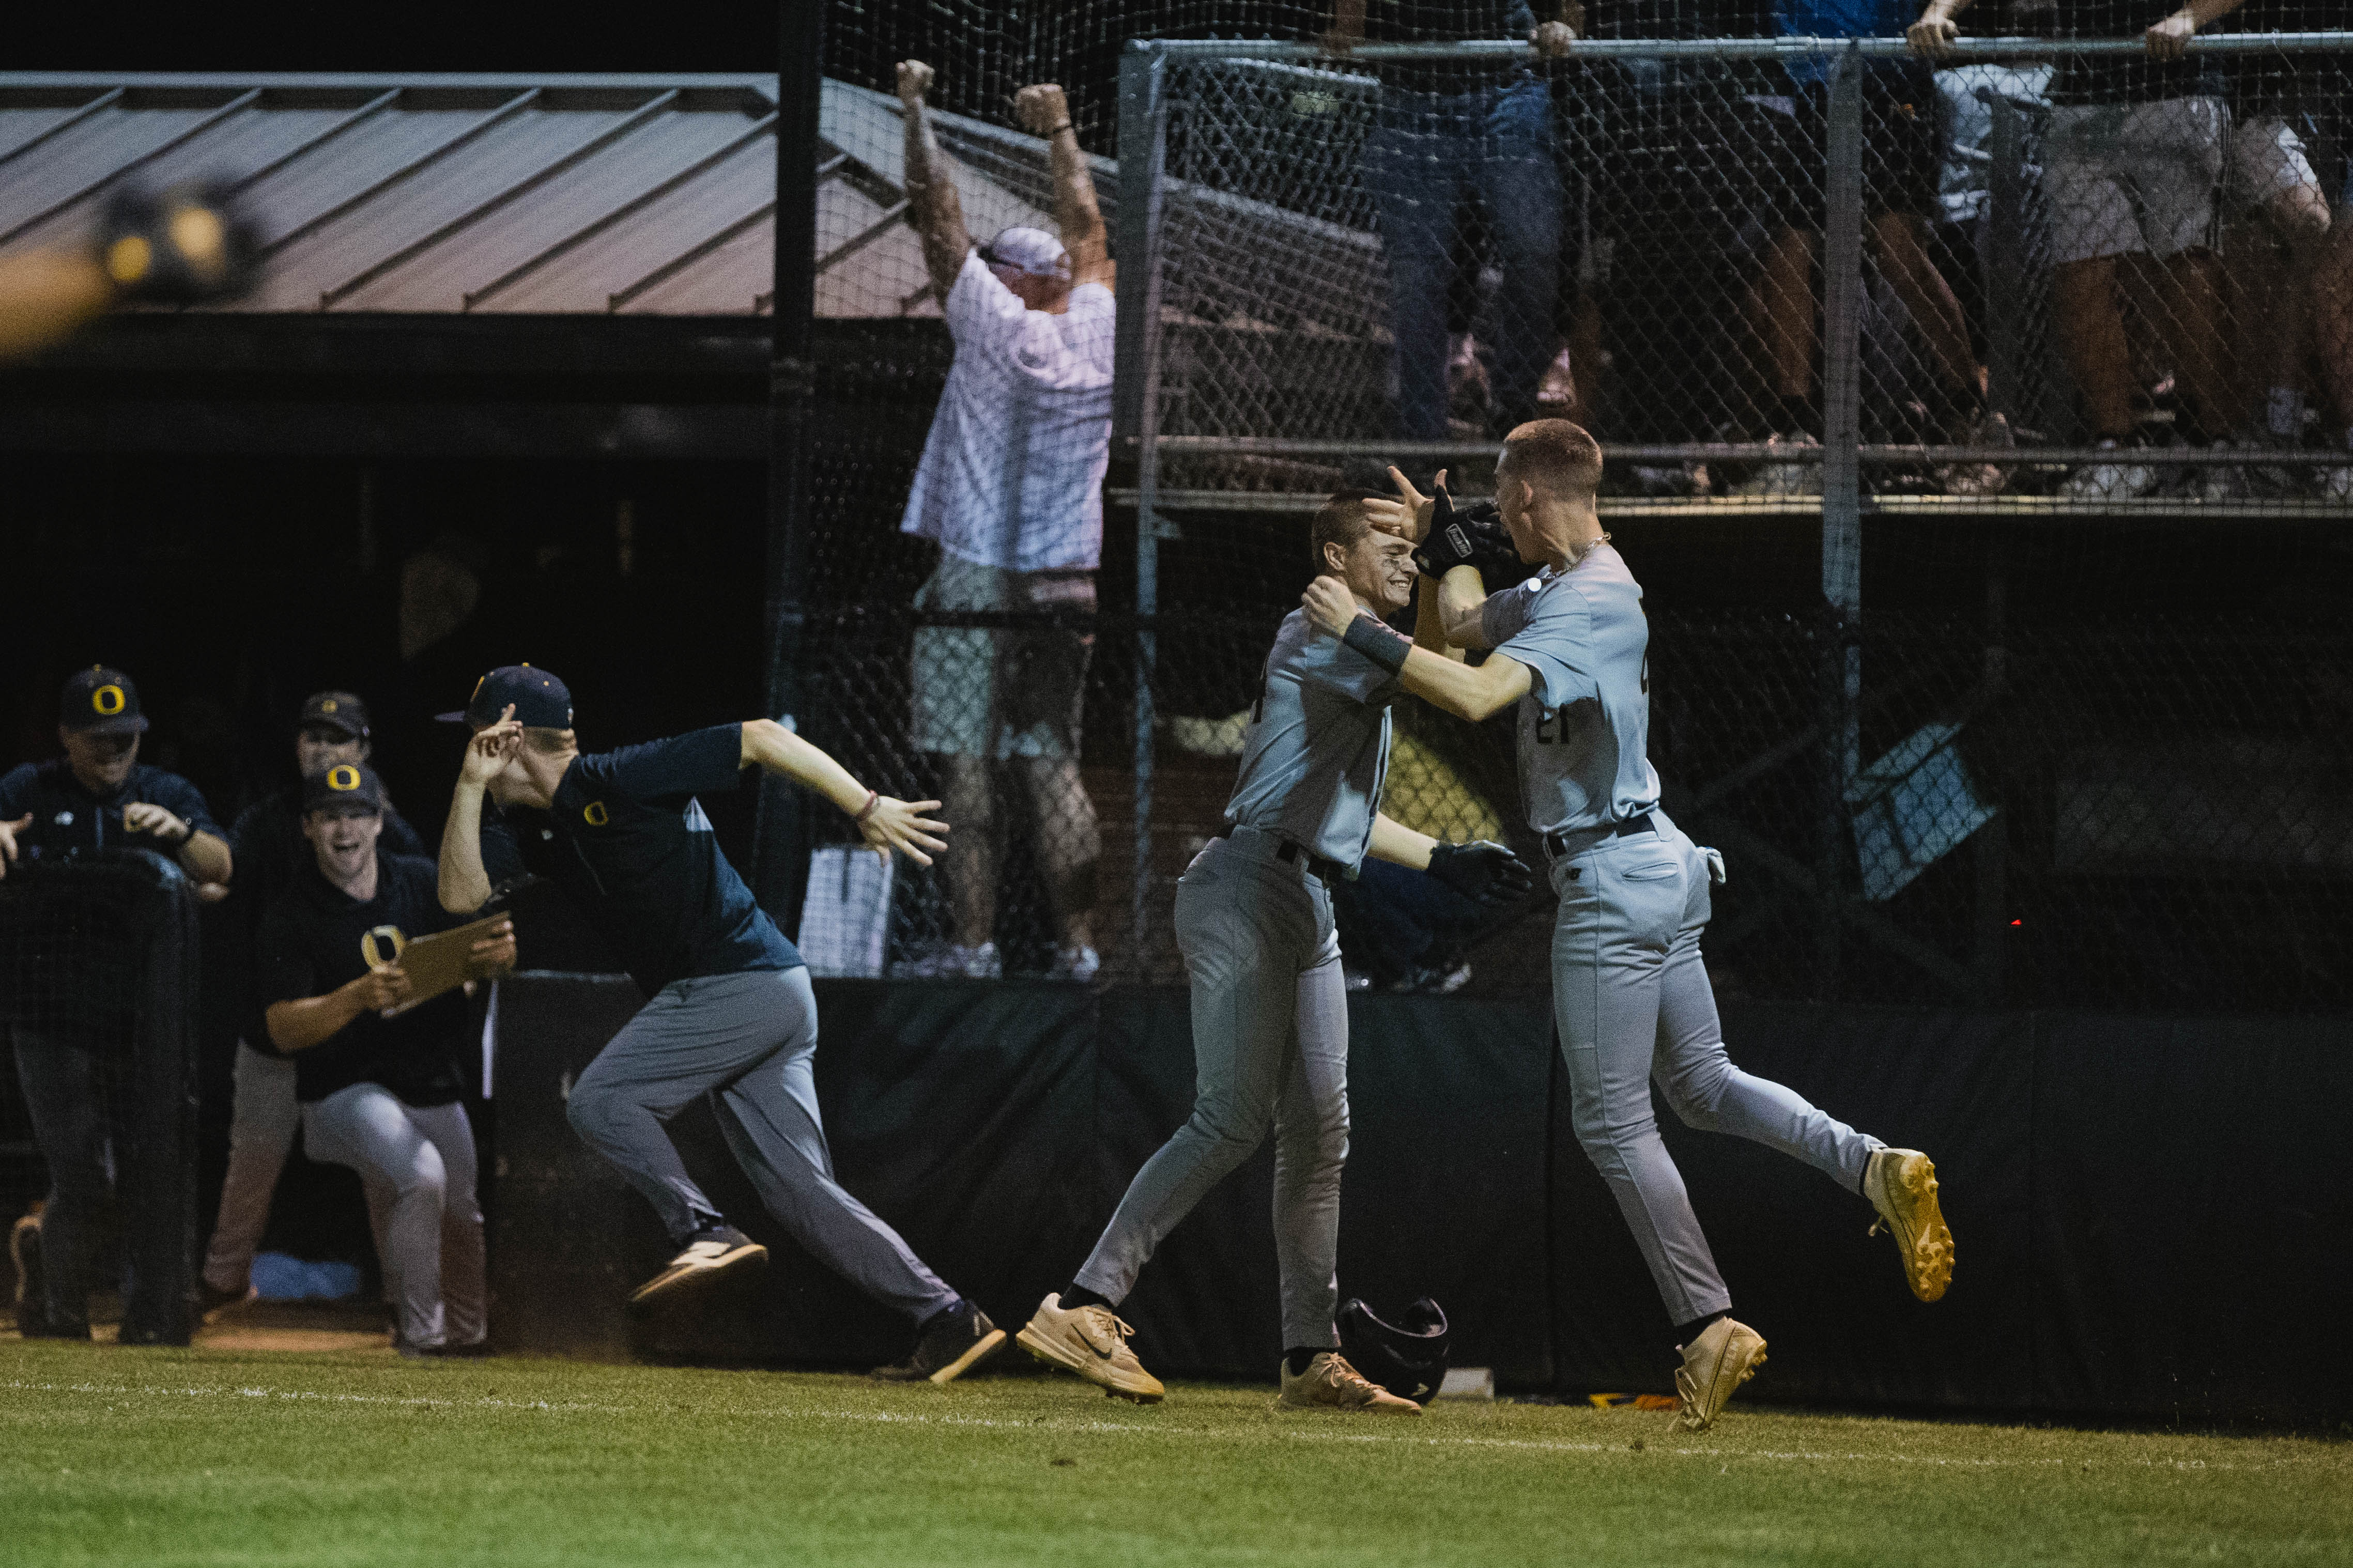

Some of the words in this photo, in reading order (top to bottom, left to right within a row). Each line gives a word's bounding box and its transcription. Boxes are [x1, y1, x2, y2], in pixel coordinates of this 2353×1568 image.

[93, 685, 125, 715] O
[327, 765, 361, 791] O
[583, 800, 608, 826] O
[361, 924, 405, 969] O
